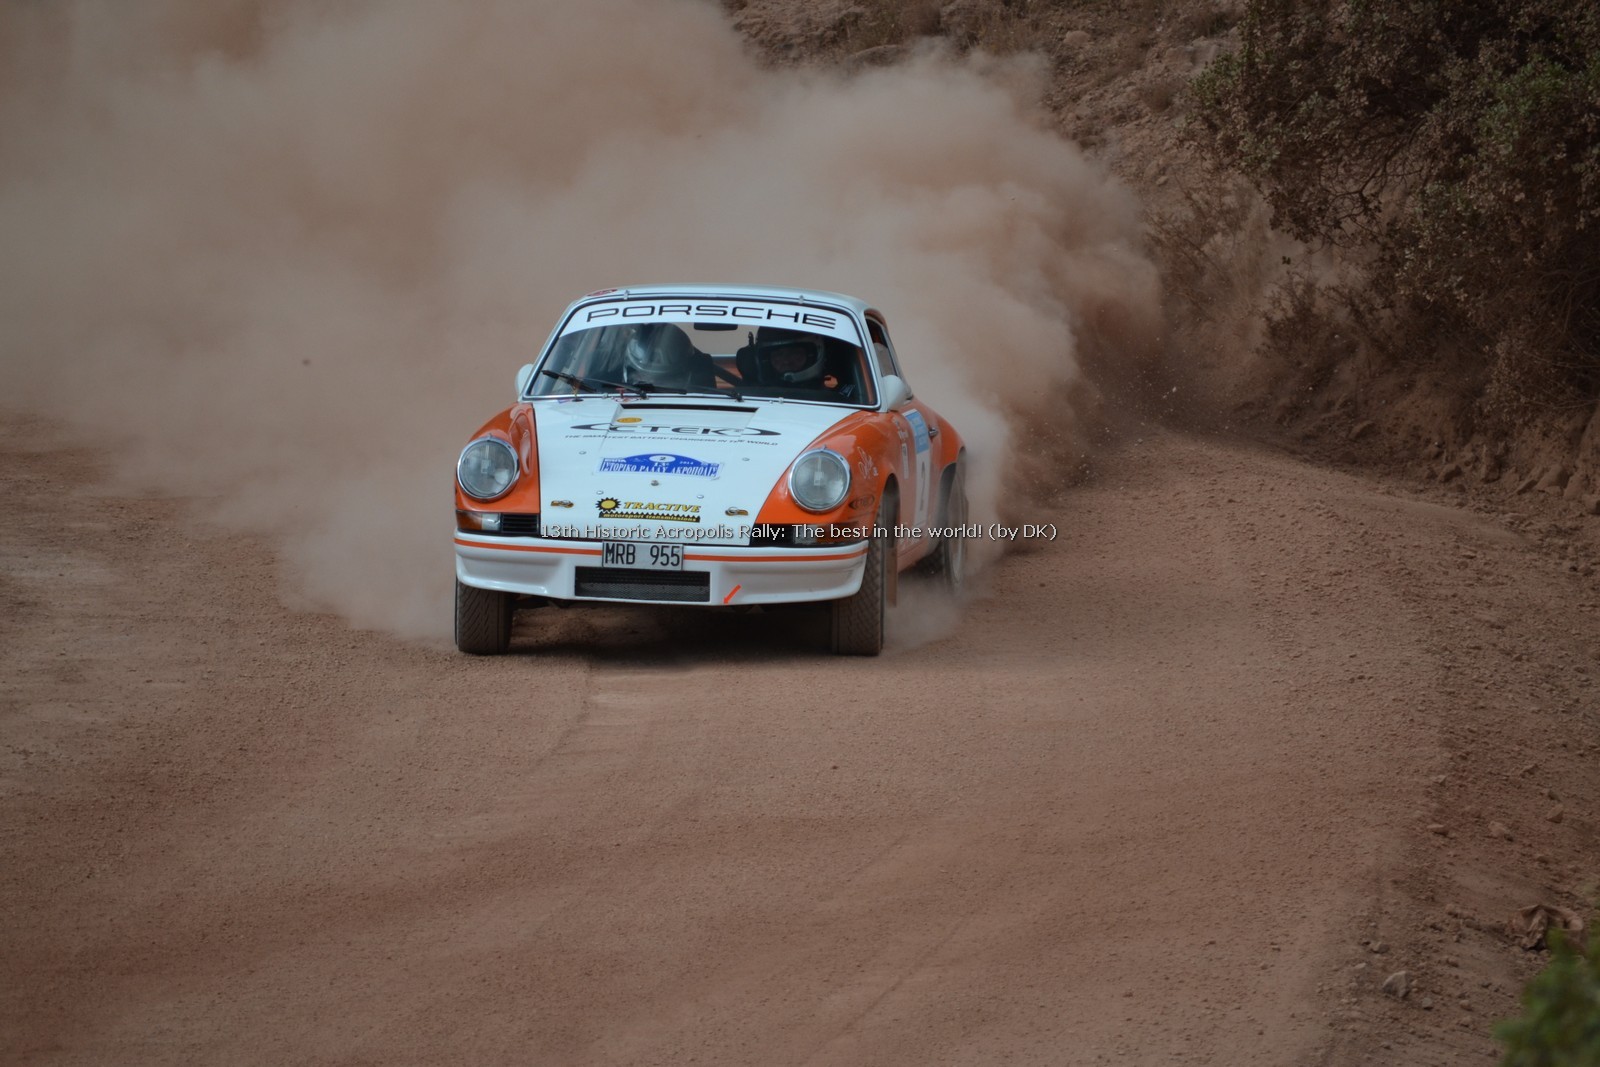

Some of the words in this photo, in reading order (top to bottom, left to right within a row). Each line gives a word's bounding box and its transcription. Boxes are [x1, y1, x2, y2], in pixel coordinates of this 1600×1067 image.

[586, 304, 837, 330] PORSCHE
[605, 424, 745, 437] CTEK
[623, 501, 702, 513] TRACTIVE
[645, 514, 697, 522] transmissions
[604, 542, 636, 565] MRB
[650, 544, 681, 567] 955
